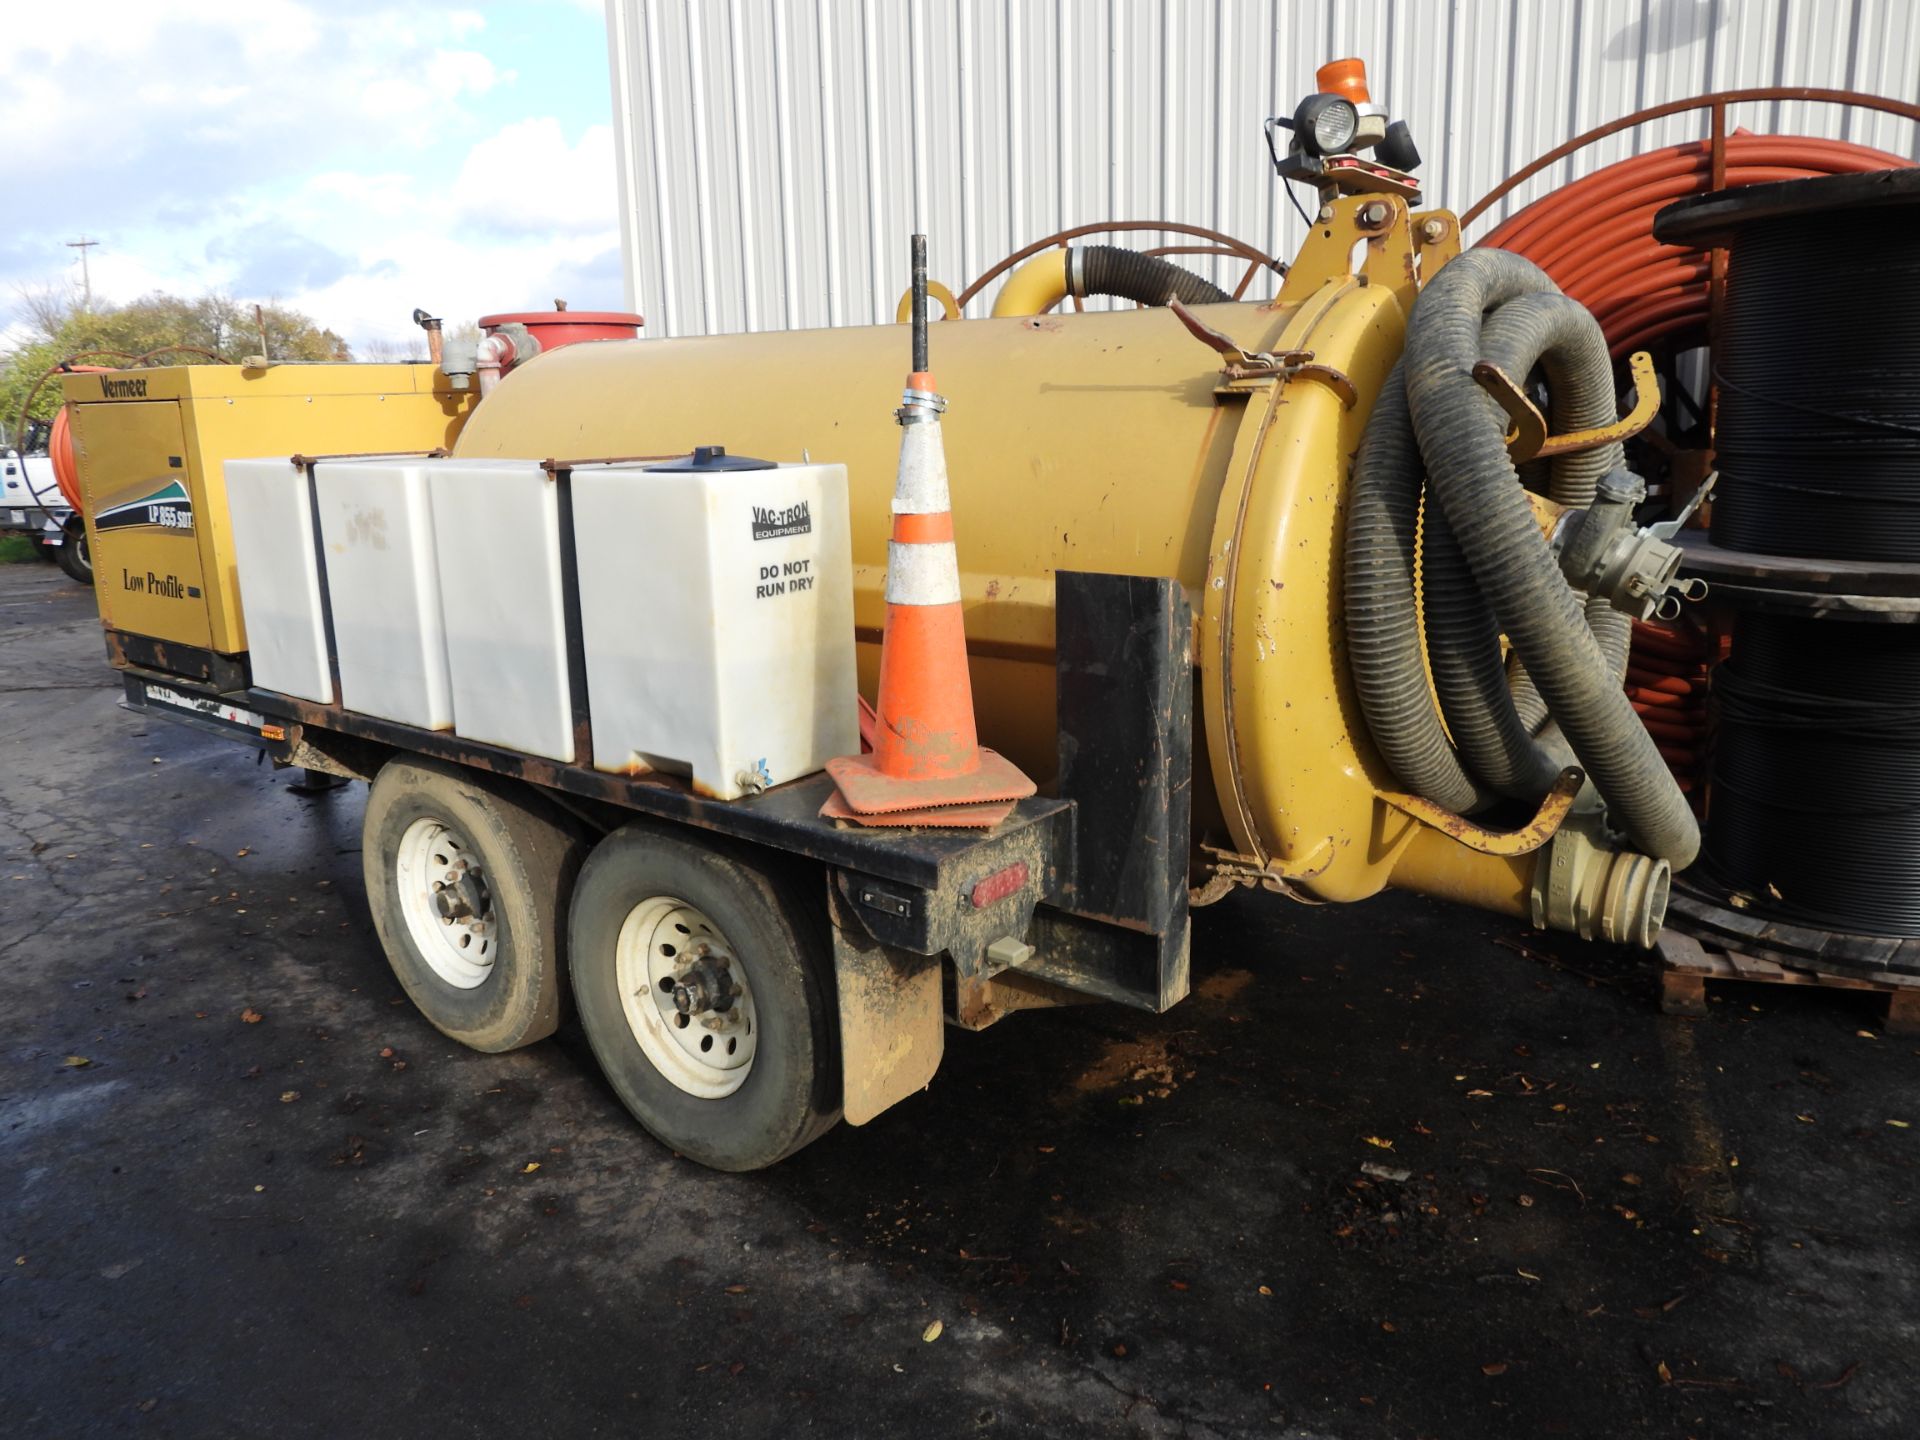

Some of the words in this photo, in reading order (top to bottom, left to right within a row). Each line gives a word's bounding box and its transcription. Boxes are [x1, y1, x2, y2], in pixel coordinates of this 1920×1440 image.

[99, 374, 148, 398] Vermeer
[148, 505, 158, 523] LP
[752, 499, 809, 526] VAC-TRON
[755, 524, 809, 539] EQUIPMENT
[760, 565, 779, 580] DO
[783, 559, 810, 576] NOT
[123, 568, 144, 592] Low
[147, 571, 184, 599] Profile
[756, 581, 785, 599] RUN
[789, 576, 814, 593] DRY
